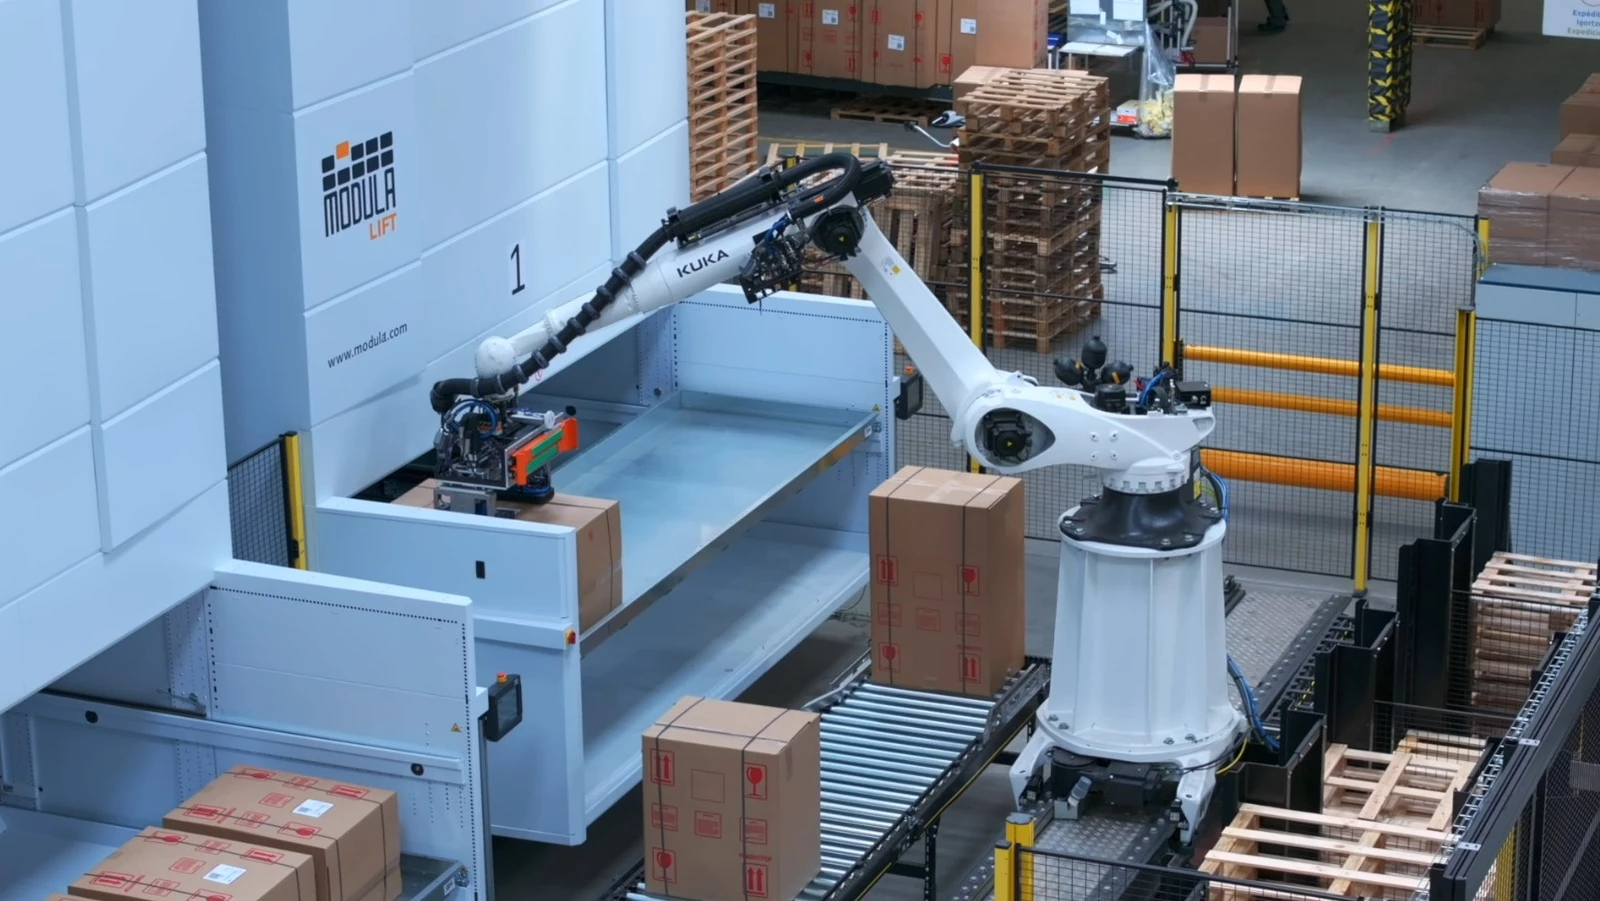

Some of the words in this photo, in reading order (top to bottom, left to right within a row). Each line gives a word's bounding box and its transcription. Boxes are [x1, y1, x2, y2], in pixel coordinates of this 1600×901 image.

[323, 167, 396, 238] MODULA
[369, 212, 397, 240] LIFT
[510, 243, 526, 295] 1
[676, 249, 729, 278] KUKA
[327, 323, 408, 368] www.modula.com
